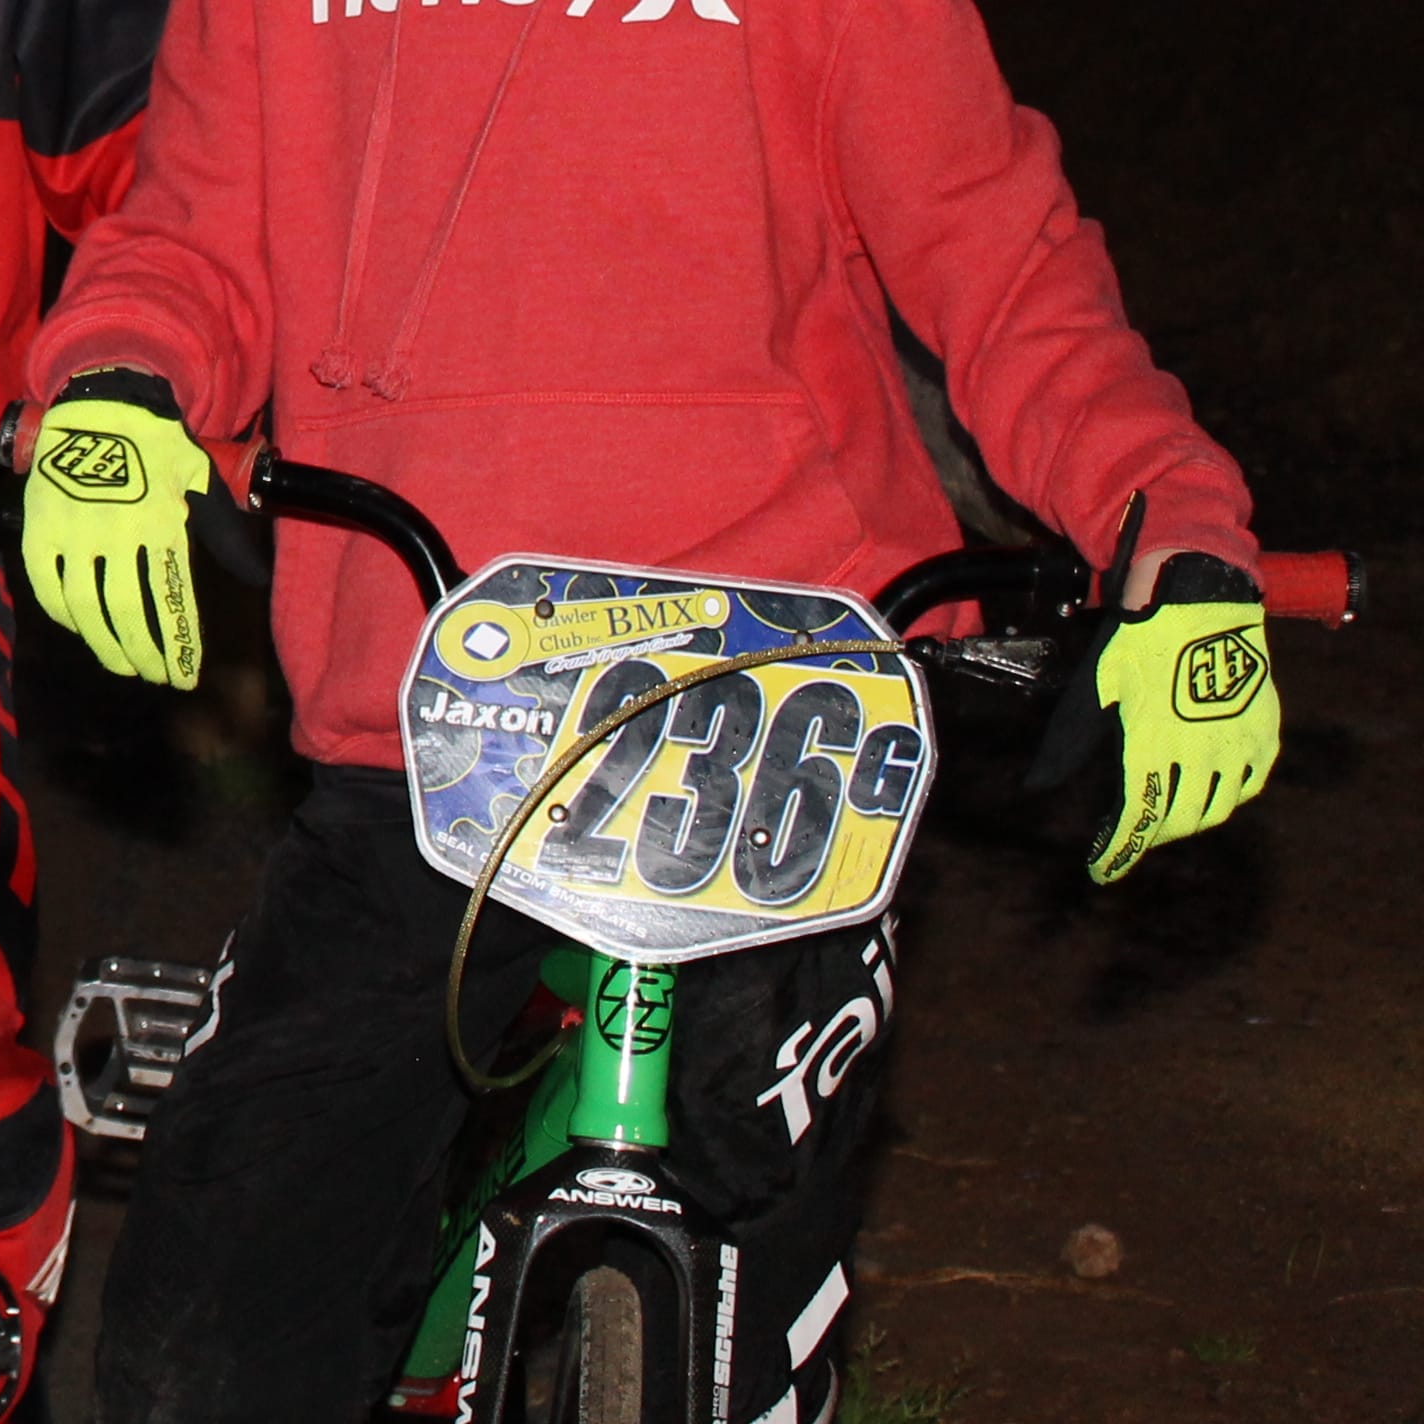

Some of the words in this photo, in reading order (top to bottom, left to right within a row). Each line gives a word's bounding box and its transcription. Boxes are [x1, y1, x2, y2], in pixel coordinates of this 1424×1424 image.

[604, 597, 697, 638] BMX
[539, 632, 583, 653] Club
[419, 690, 554, 736] Jaxon
[534, 658, 865, 907] 236
[846, 722, 924, 818] G
[435, 831, 475, 858] SEAL
[547, 1187, 683, 1215] ANSWER
